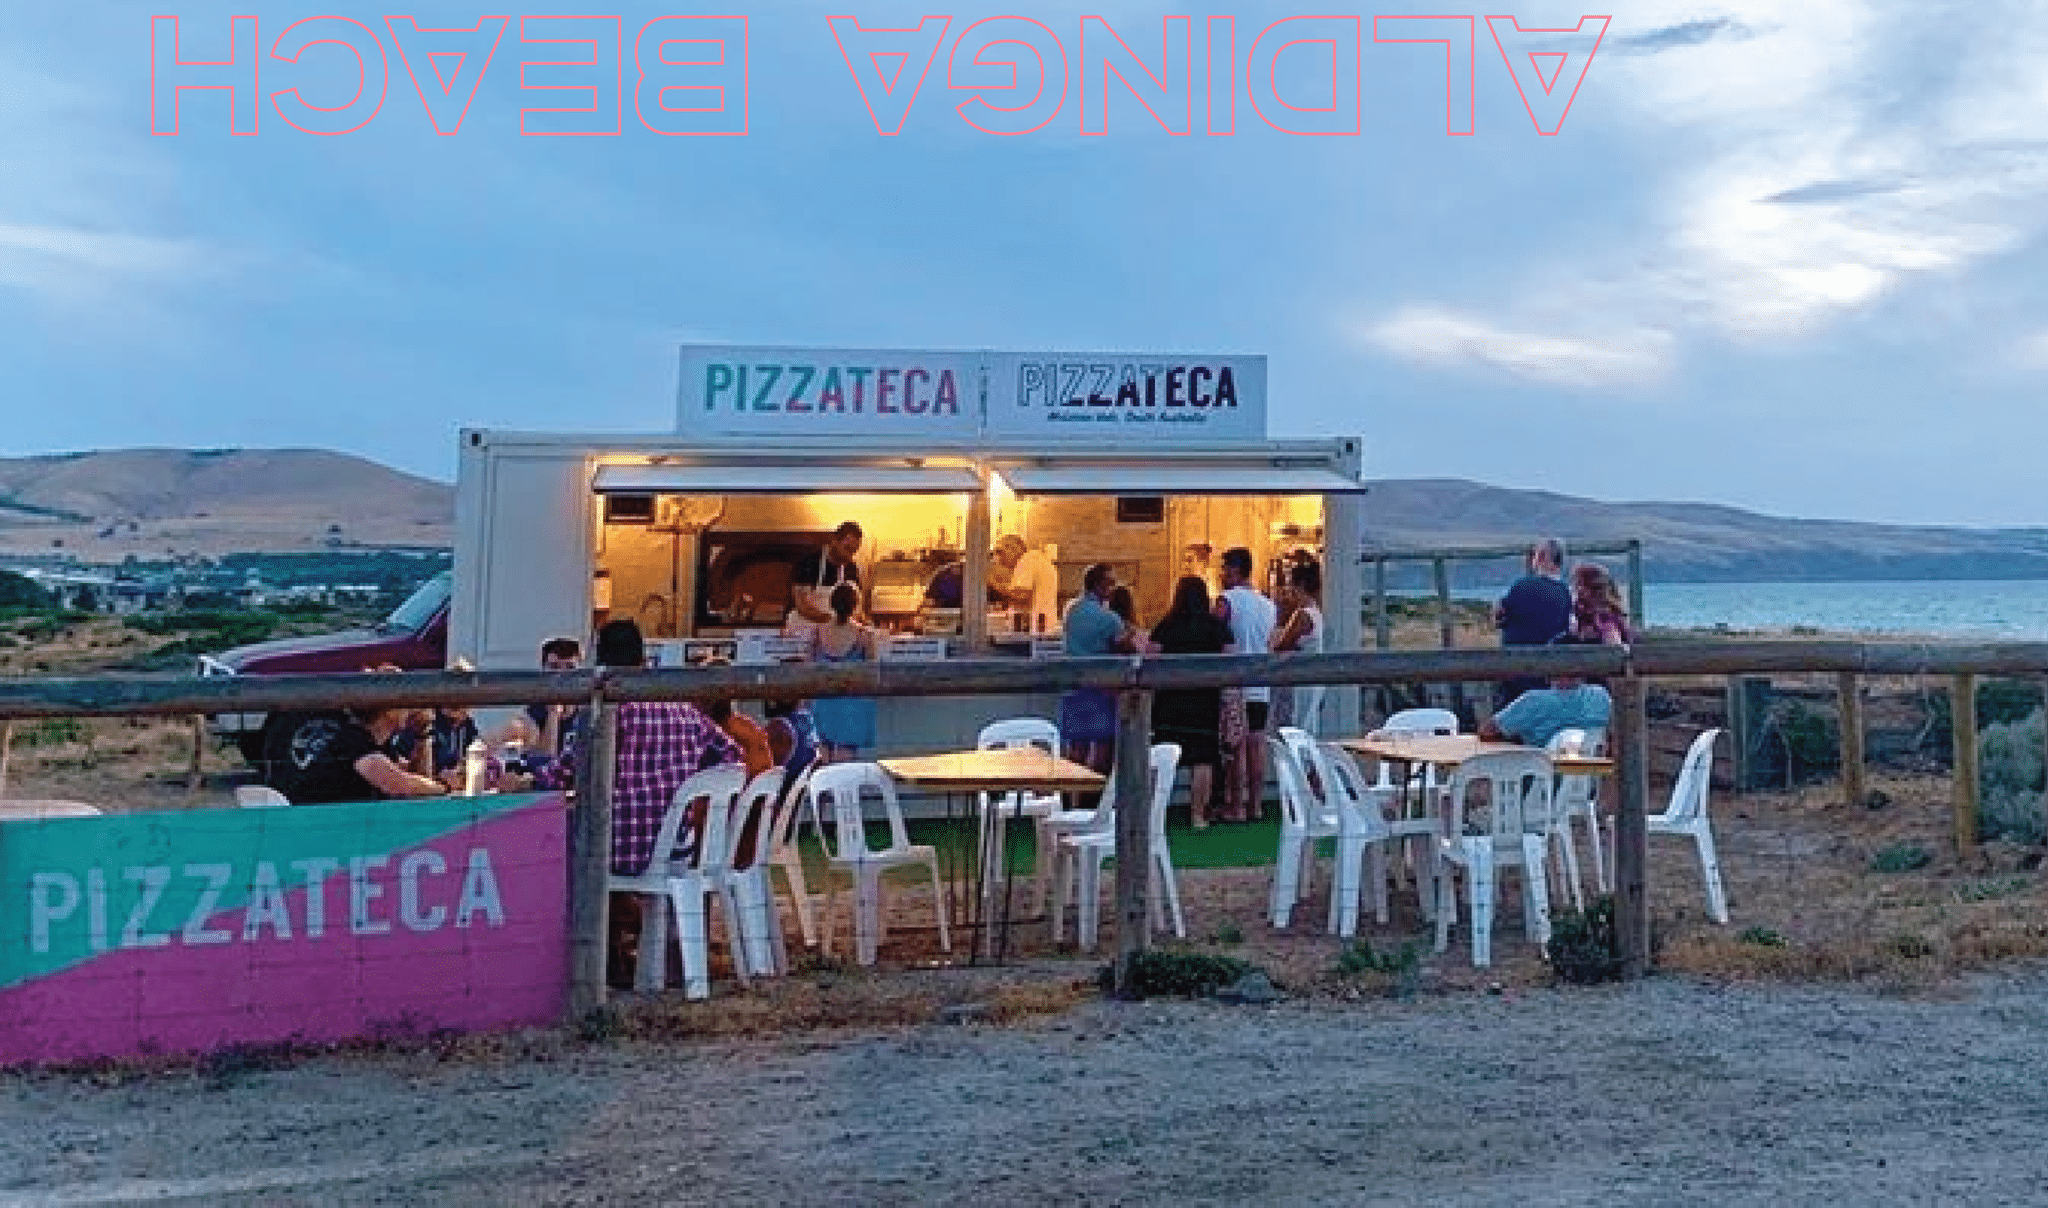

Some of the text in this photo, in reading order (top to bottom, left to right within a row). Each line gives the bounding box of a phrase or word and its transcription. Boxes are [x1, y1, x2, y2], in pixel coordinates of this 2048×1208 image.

[704, 363, 961, 415] PIZZATECA
[1017, 363, 1238, 408] PIZZATECA
[30, 847, 505, 953] PIZZATECA
